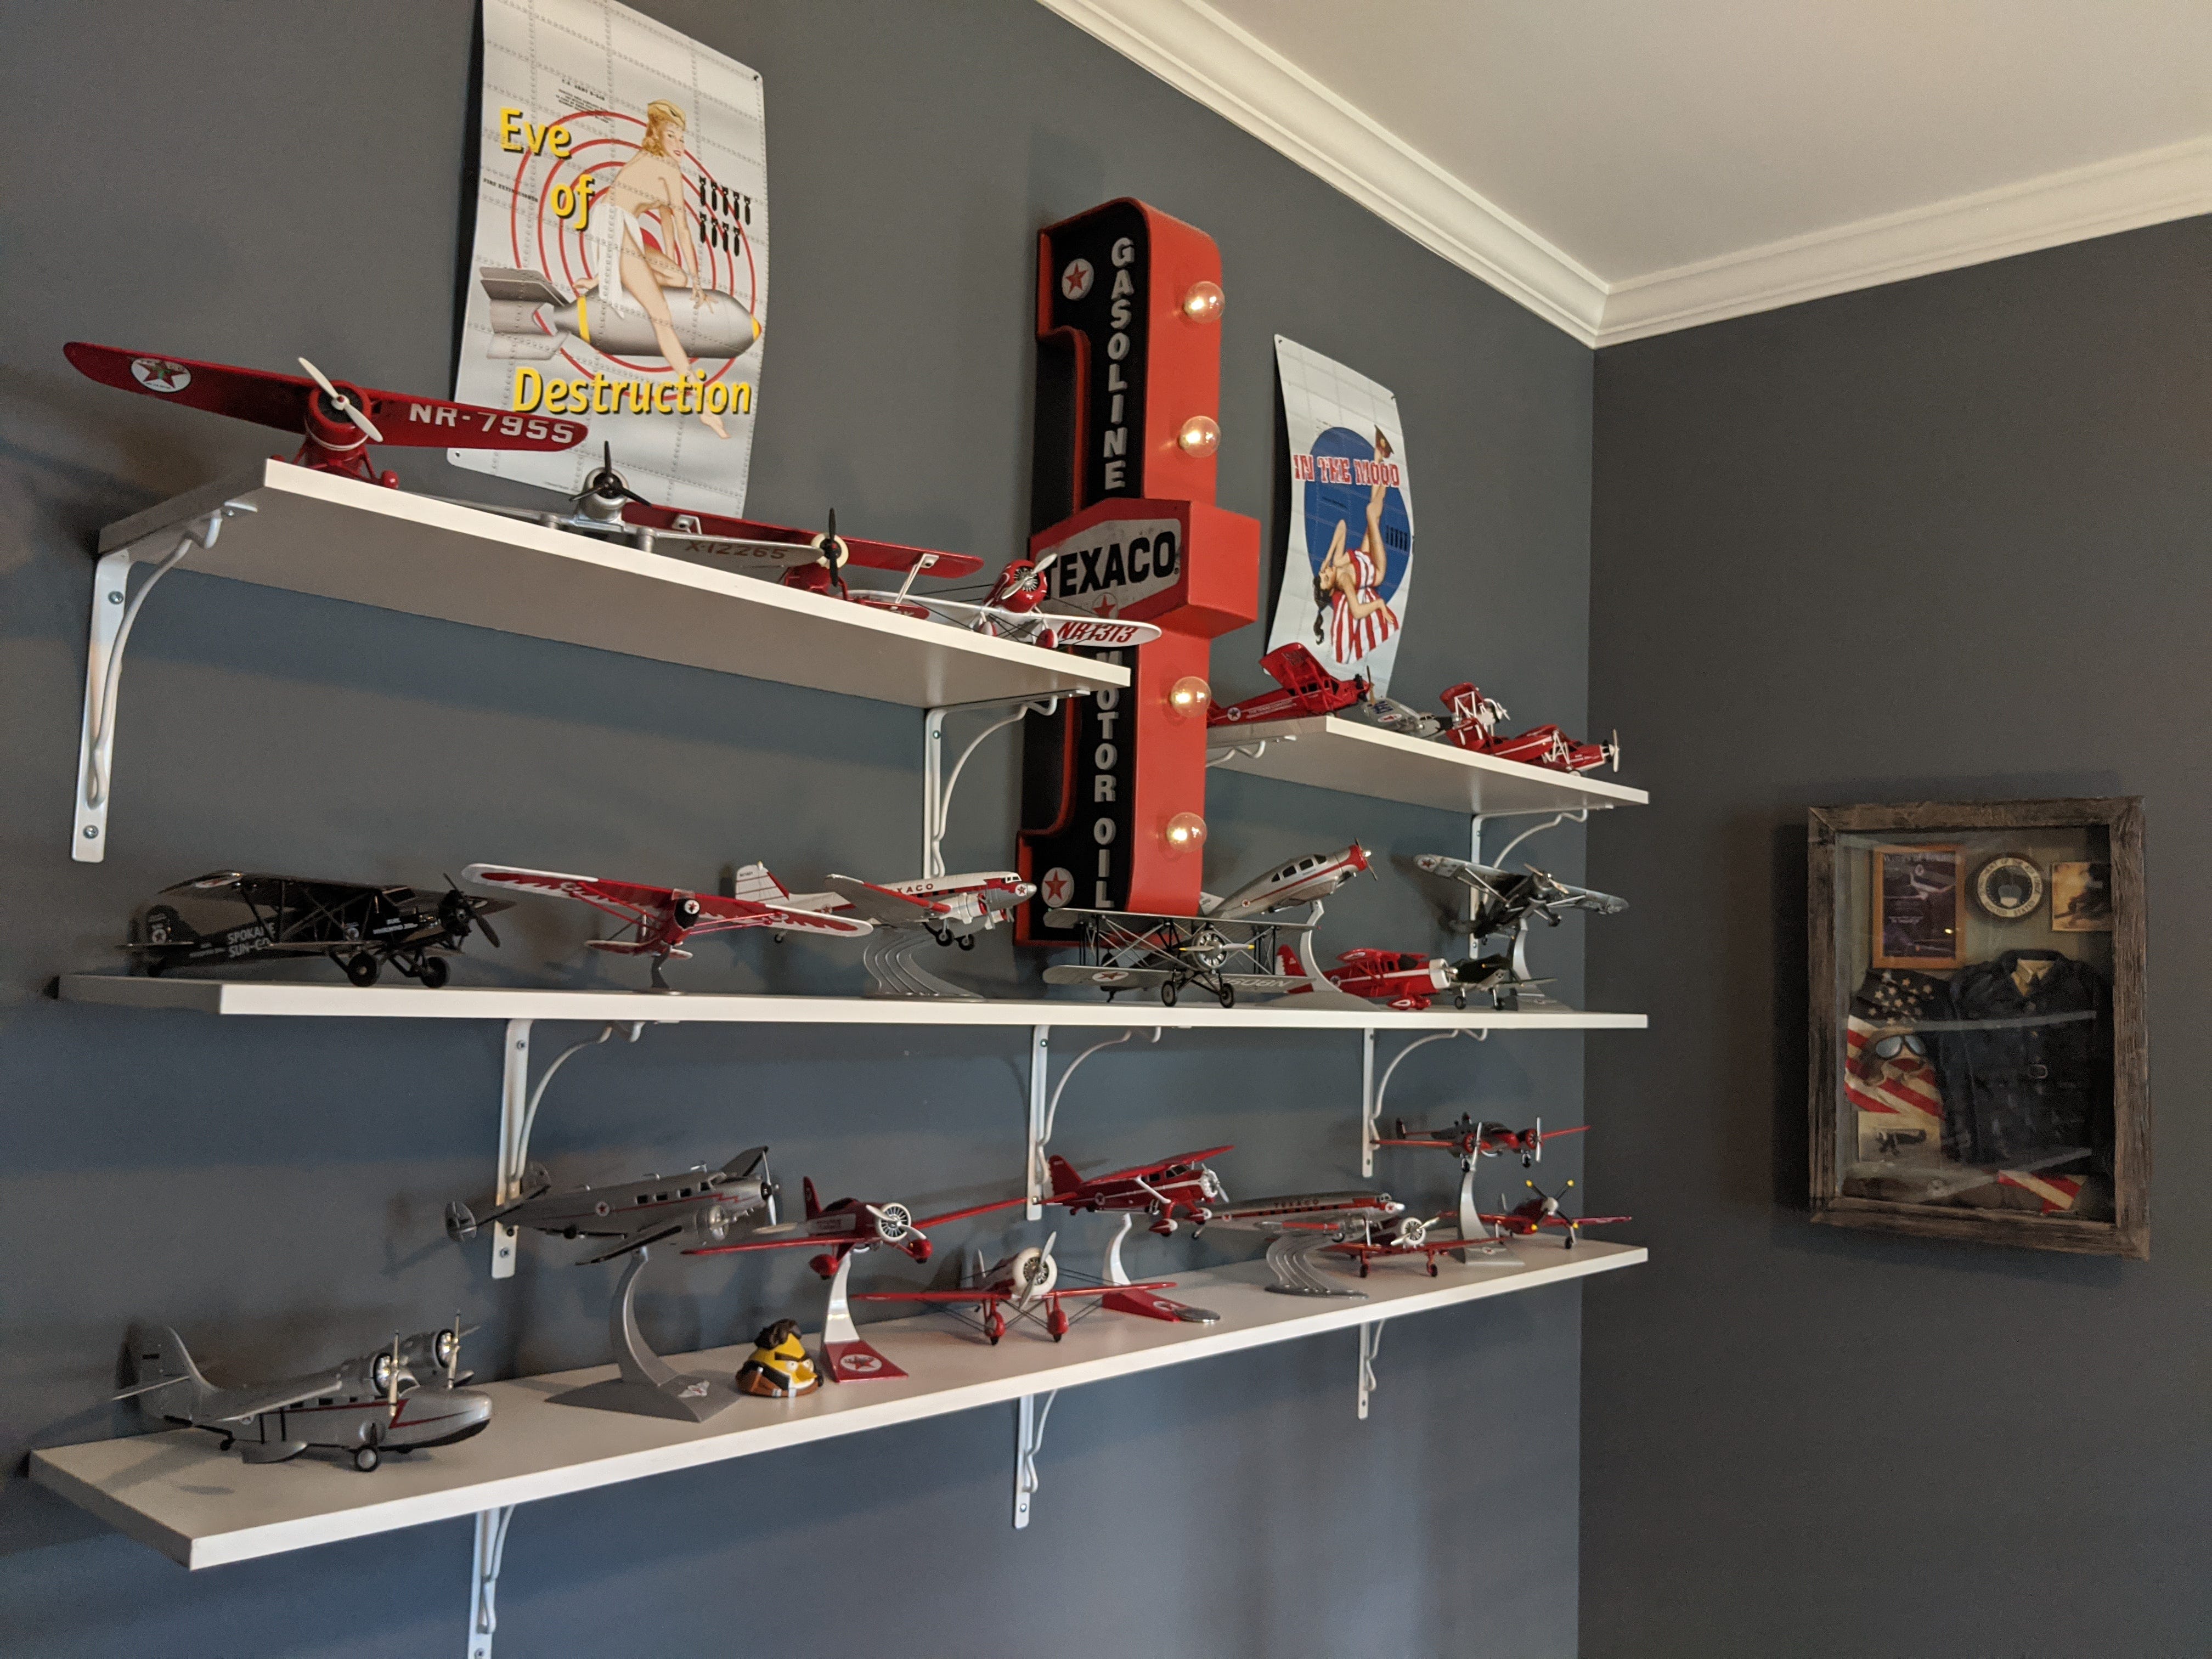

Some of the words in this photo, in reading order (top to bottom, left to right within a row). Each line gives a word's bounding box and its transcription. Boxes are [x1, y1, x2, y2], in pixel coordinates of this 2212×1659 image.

[499, 106, 574, 160] Eve
[550, 174, 595, 232] of
[1103, 236, 1135, 490] GASOLINE
[513, 366, 752, 415] Destruction
[409, 403, 575, 444] NR-7955
[1293, 454, 1315, 482] IN
[1317, 456, 1352, 484] THE
[1353, 459, 1401, 488] MOOD
[685, 540, 788, 560] X-12265
[1043, 531, 1176, 601] TEXACO
[1058, 622, 1139, 643] NR1313
[1094, 817, 1116, 909] OIL
[897, 883, 934, 893] XACO
